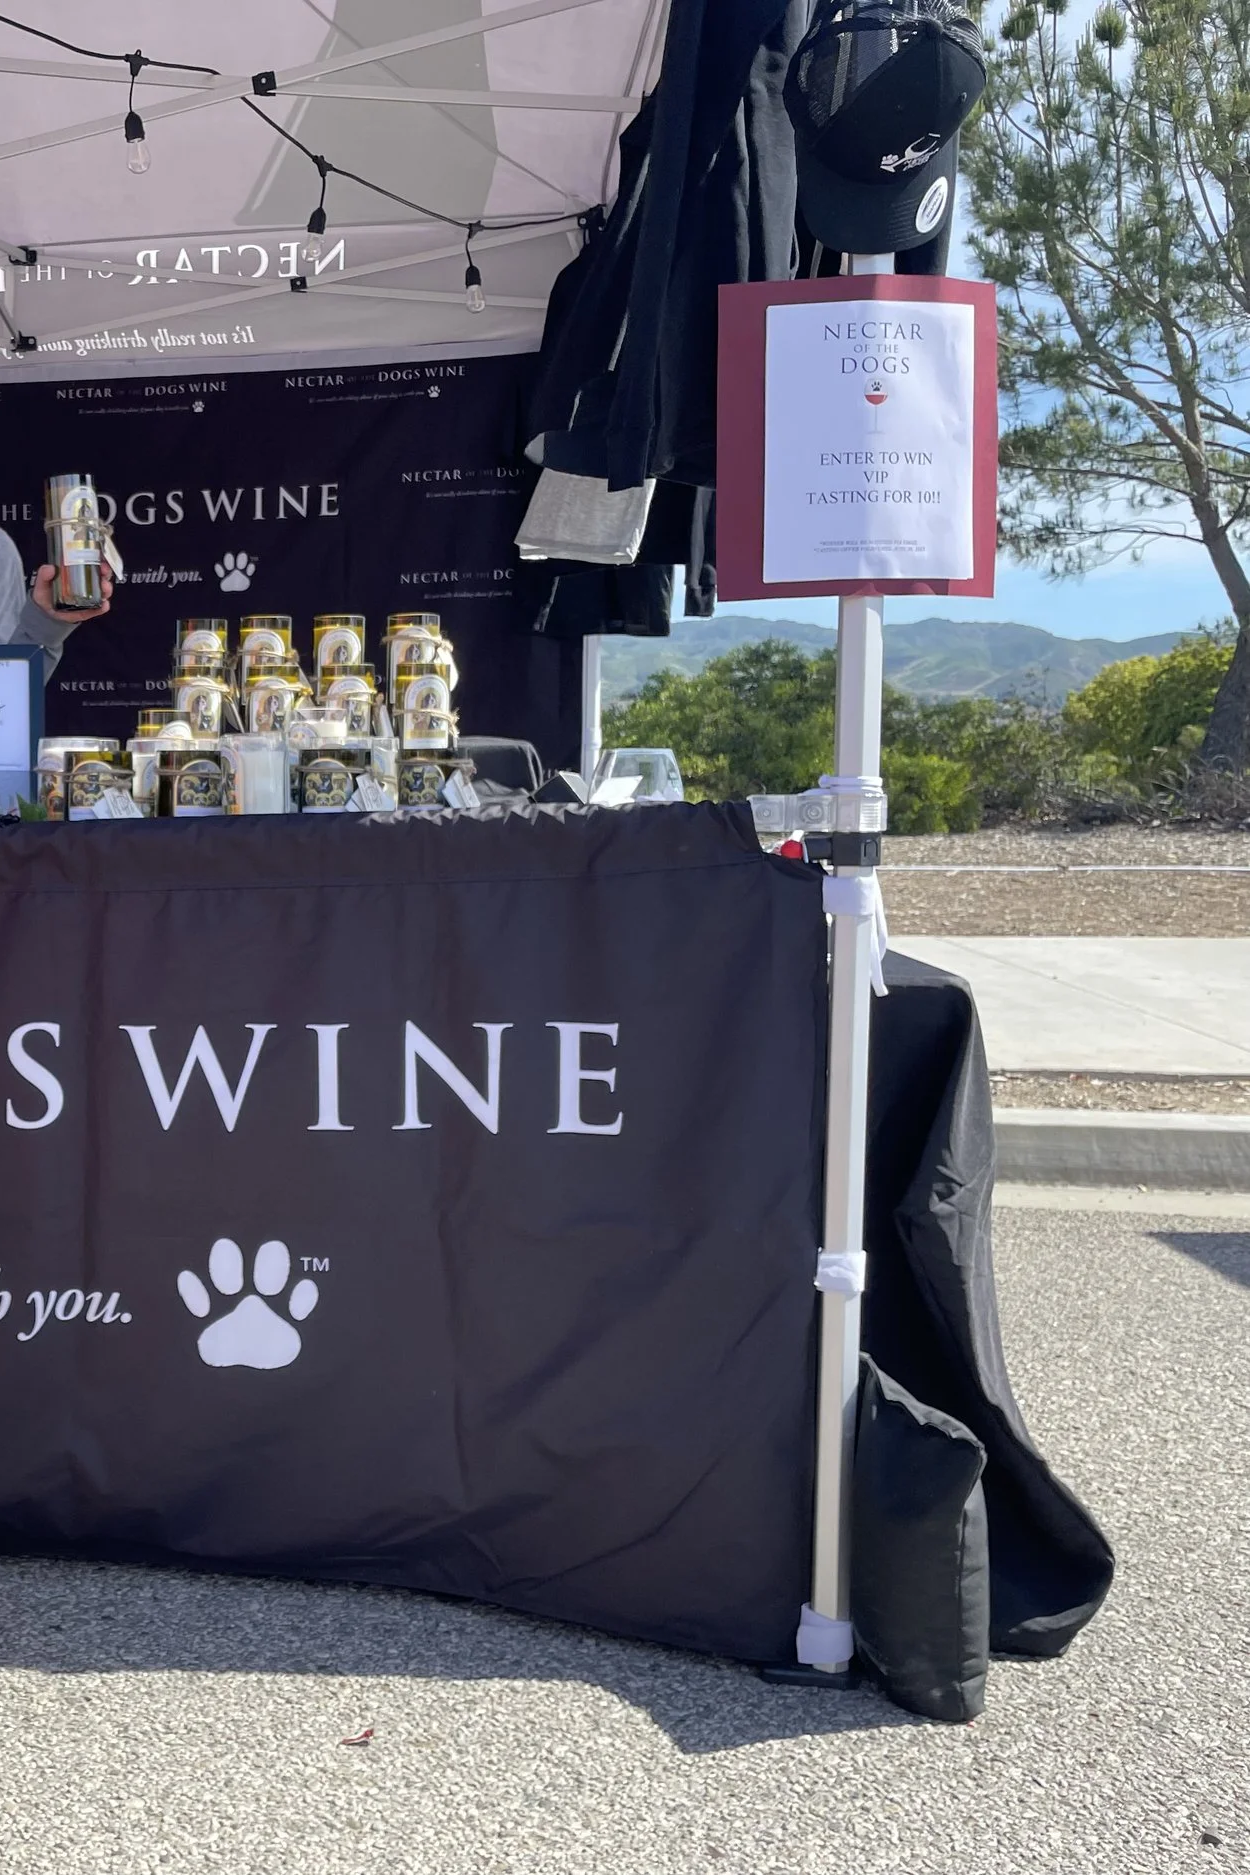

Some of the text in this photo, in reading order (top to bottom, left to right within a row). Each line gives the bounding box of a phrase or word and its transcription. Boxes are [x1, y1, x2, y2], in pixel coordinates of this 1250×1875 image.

[823, 321, 924, 341] NECTAR
[853, 343, 899, 354] OF THE
[841, 356, 910, 375] DOGS
[285, 374, 345, 388] NECTAR
[378, 368, 421, 382] DOGS
[424, 365, 466, 378] WINE
[56, 388, 113, 400] NECTAR
[144, 383, 186, 397] DOGS
[188, 380, 228, 393] WINE
[820, 451, 933, 466] ENTER TO WIN
[401, 468, 462, 483] NECTAR
[863, 470, 889, 484] VIP
[96, 489, 186, 526] OGS
[200, 482, 340, 523] WINE
[805, 490, 941, 505] TASTING FOR 10!!
[131, 565, 168, 584] with
[170, 566, 203, 588] you.
[400, 571, 459, 585] NECTAR
[60, 681, 116, 692] NECTAR
[118, 1018, 625, 1136] WINE
[300, 1256, 330, 1273] TM
[16, 1286, 133, 1342] you.
